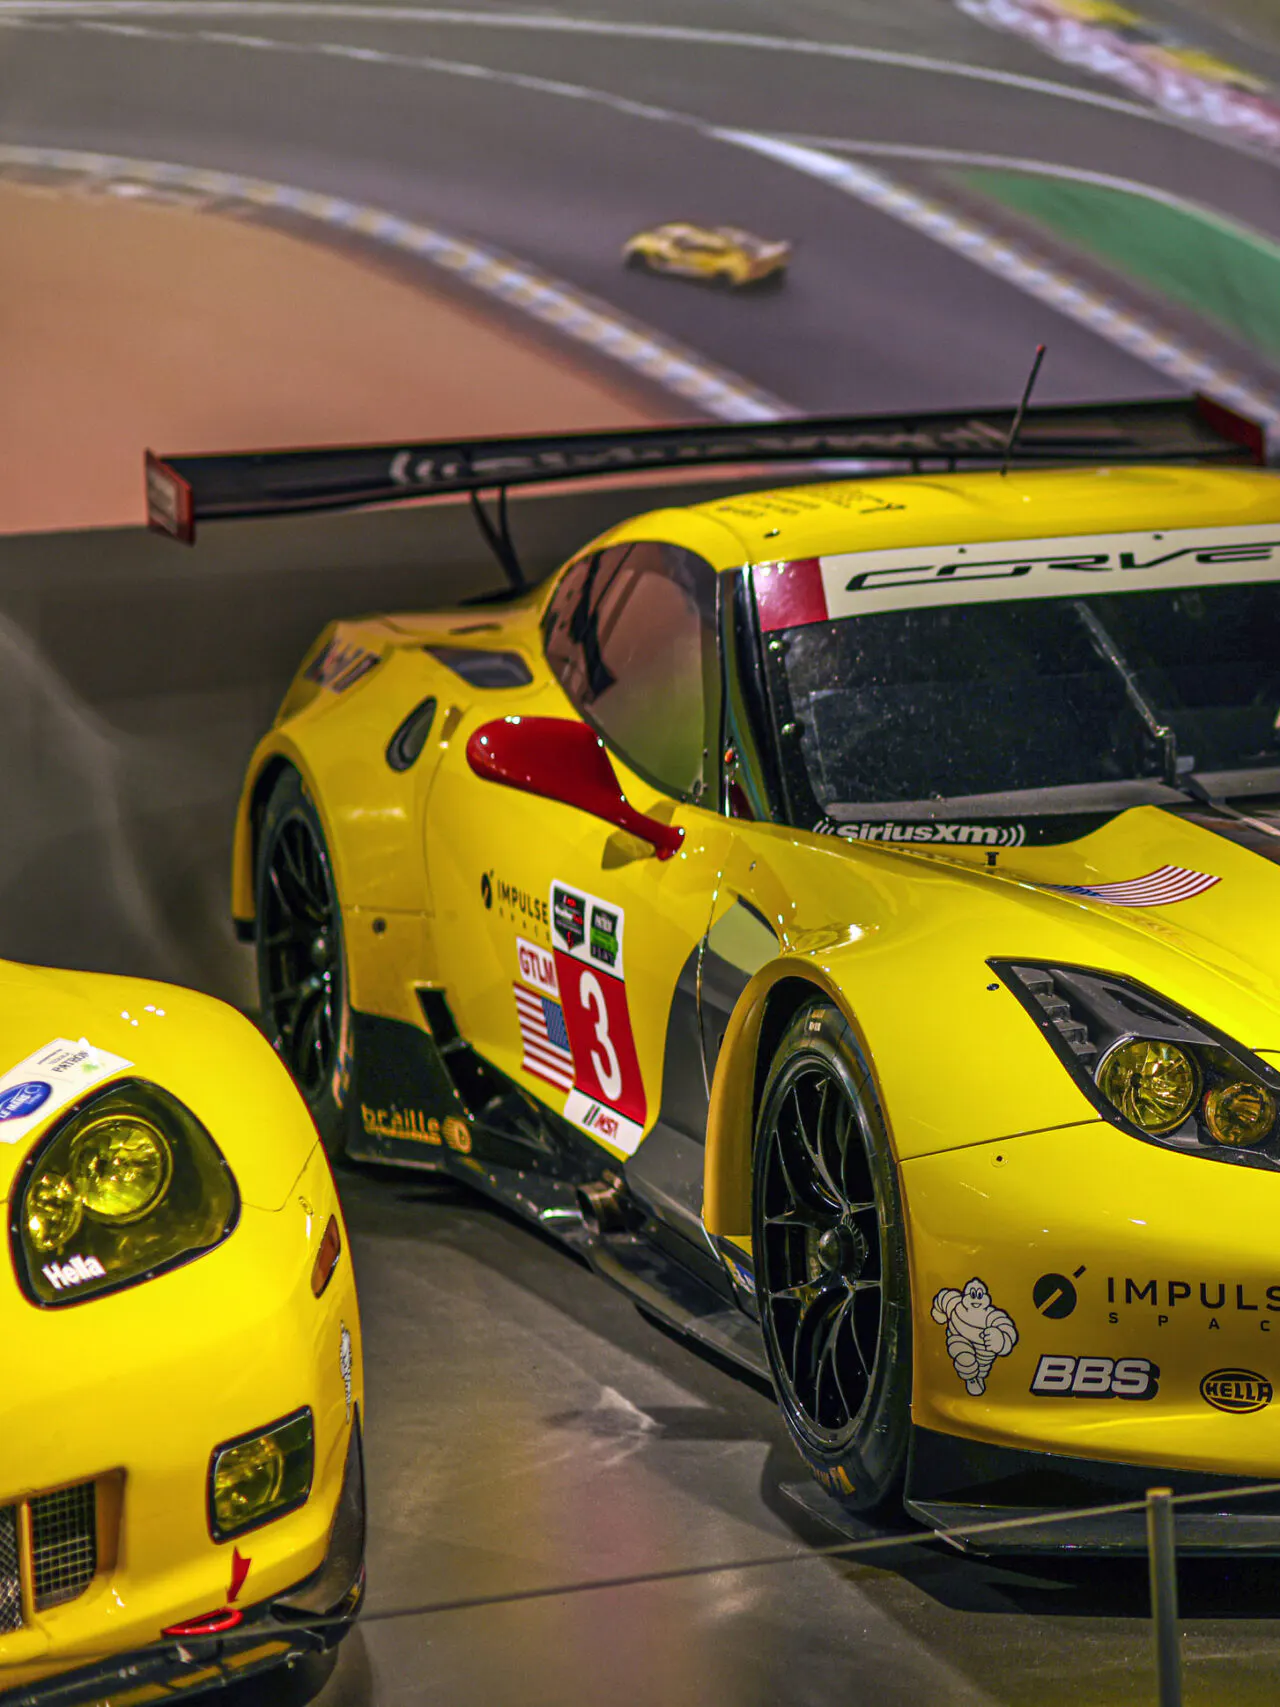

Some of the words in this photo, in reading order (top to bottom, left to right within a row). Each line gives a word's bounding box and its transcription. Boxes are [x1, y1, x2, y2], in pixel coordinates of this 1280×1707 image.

[497, 879, 549, 925] IMPULSE
[520, 945, 556, 989] GTLM
[579, 970, 622, 1101] 3
[361, 1102, 441, 1133] braille
[41, 1253, 107, 1291] Hella
[1030, 1354, 1158, 1399] BBS
[1206, 1379, 1273, 1402] HELLA
